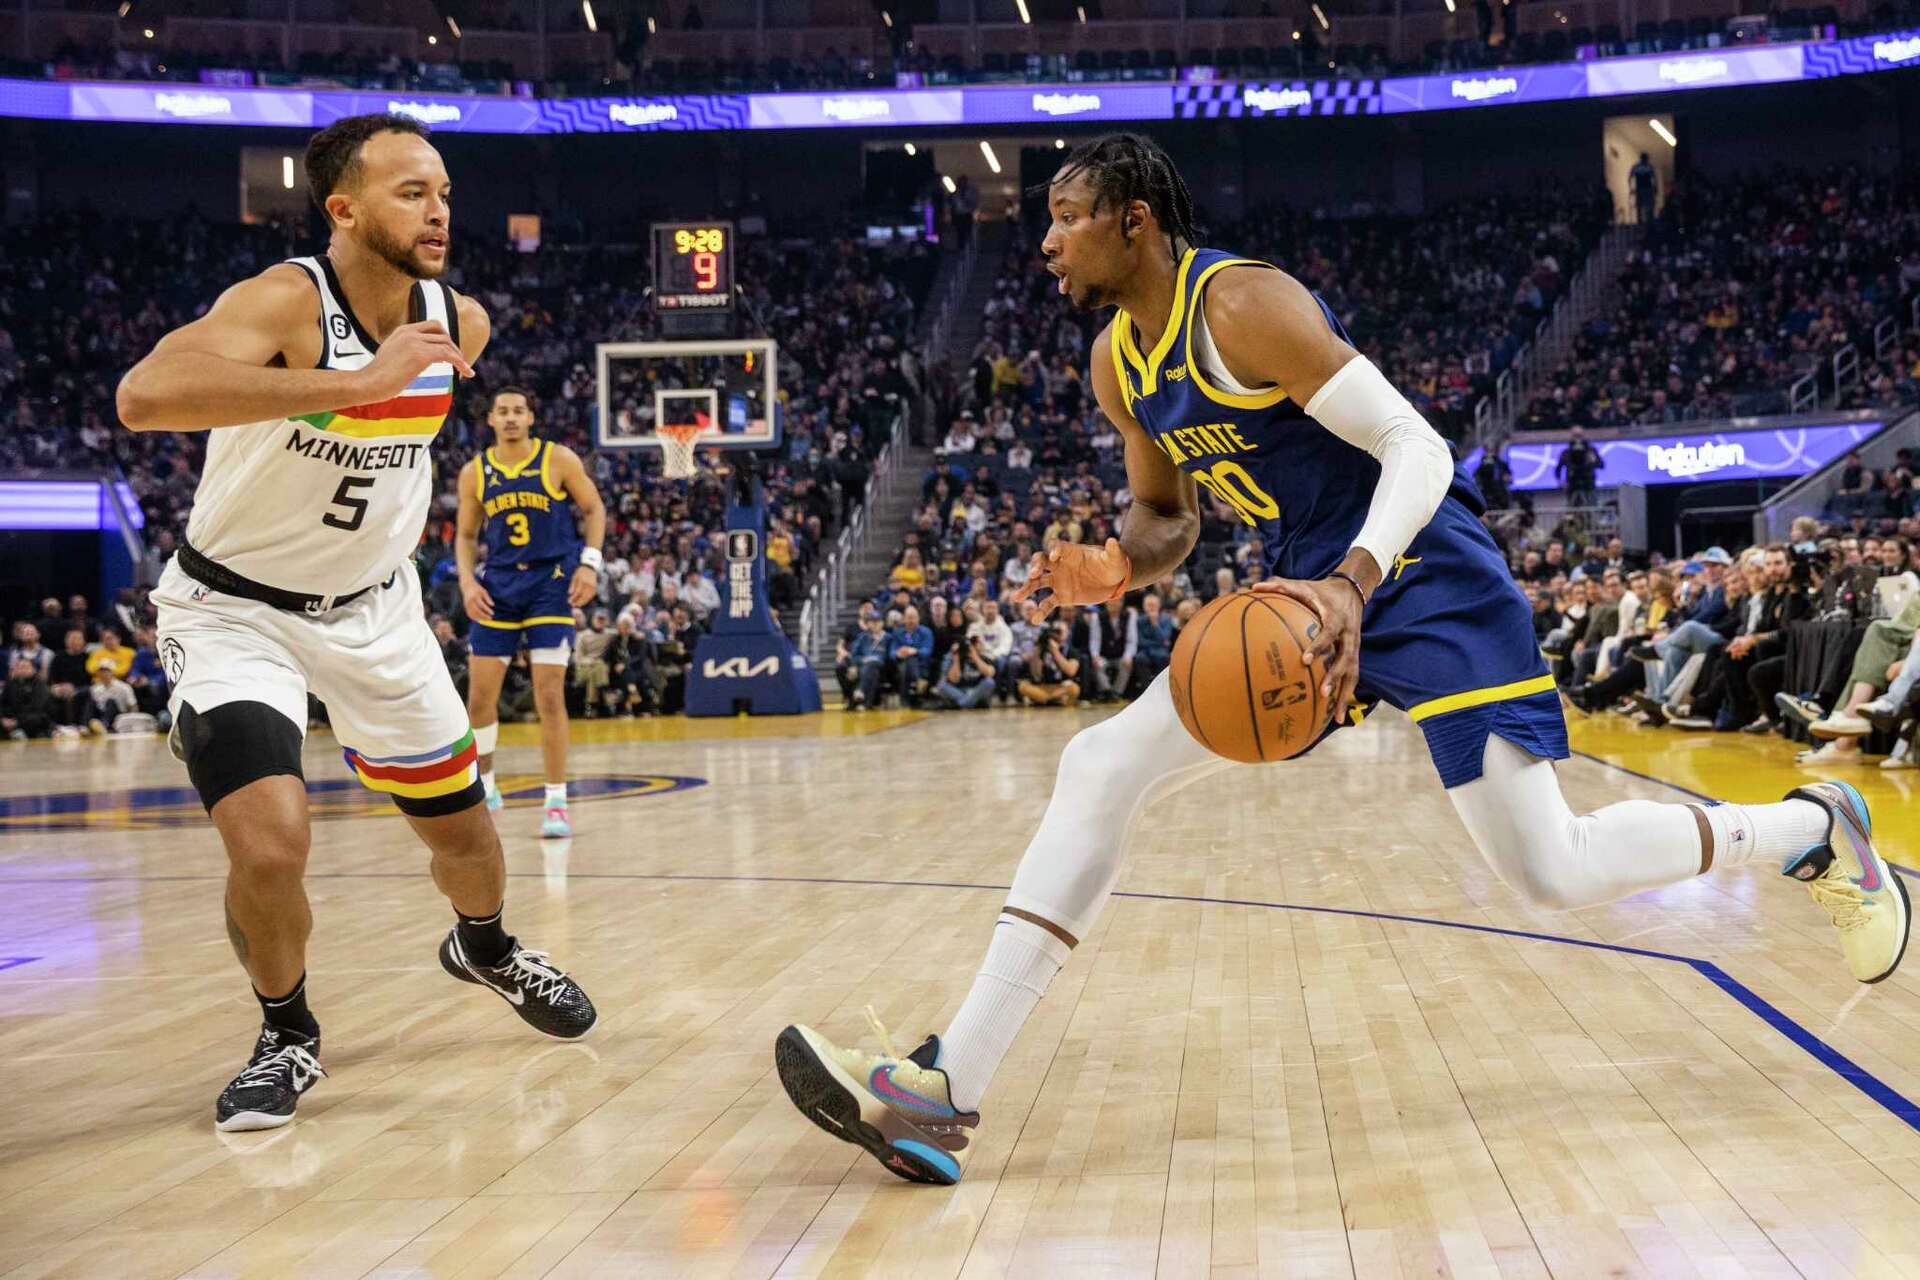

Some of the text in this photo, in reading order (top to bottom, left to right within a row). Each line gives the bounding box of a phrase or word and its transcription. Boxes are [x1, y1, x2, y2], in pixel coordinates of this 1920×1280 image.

[1659, 60, 1727, 83] Rakuten
[1245, 90, 1311, 110] Rakuten
[1452, 79, 1517, 100] Rakuten
[155, 93, 232, 117] Rakuten
[609, 103, 678, 126] Rakuten
[823, 99, 890, 120] Rakuten
[1032, 95, 1101, 116] Rakuten
[674, 229, 723, 254] 9:28
[693, 252, 718, 289] 9
[333, 318, 348, 338] 6
[1173, 423, 1259, 458] STATE
[1647, 442, 1745, 477] Rakuten
[322, 475, 376, 532] 5
[506, 513, 531, 546] 3
